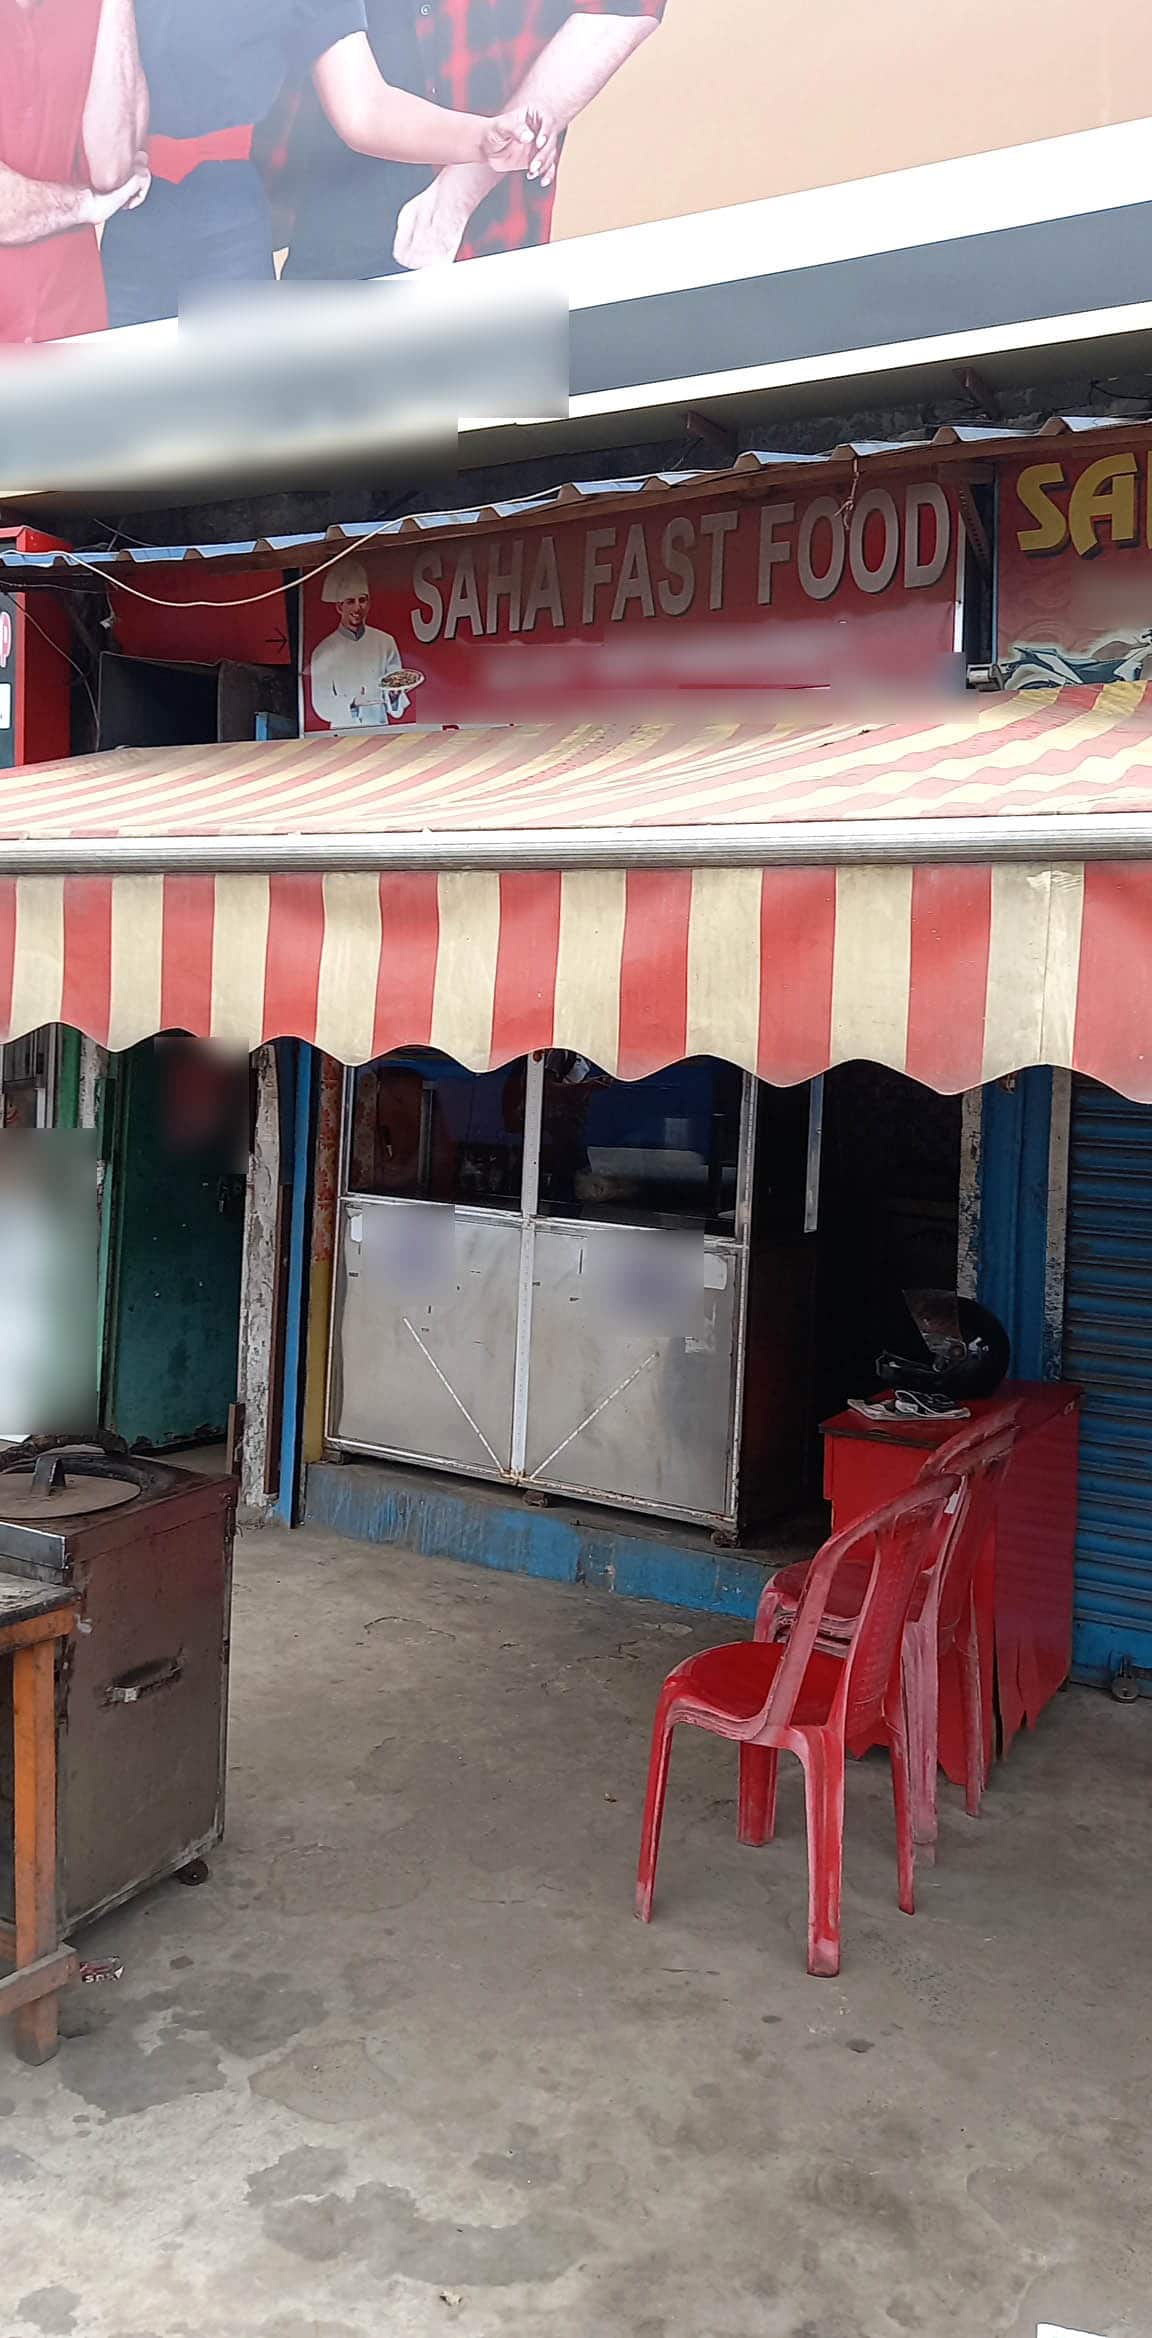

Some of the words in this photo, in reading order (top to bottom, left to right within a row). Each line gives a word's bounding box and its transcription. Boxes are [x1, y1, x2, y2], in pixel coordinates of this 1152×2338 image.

[411, 536, 565, 643] SAHA
[582, 510, 739, 625] FAST
[757, 481, 950, 606] FOOD
[1016, 450, 1152, 556] SA
